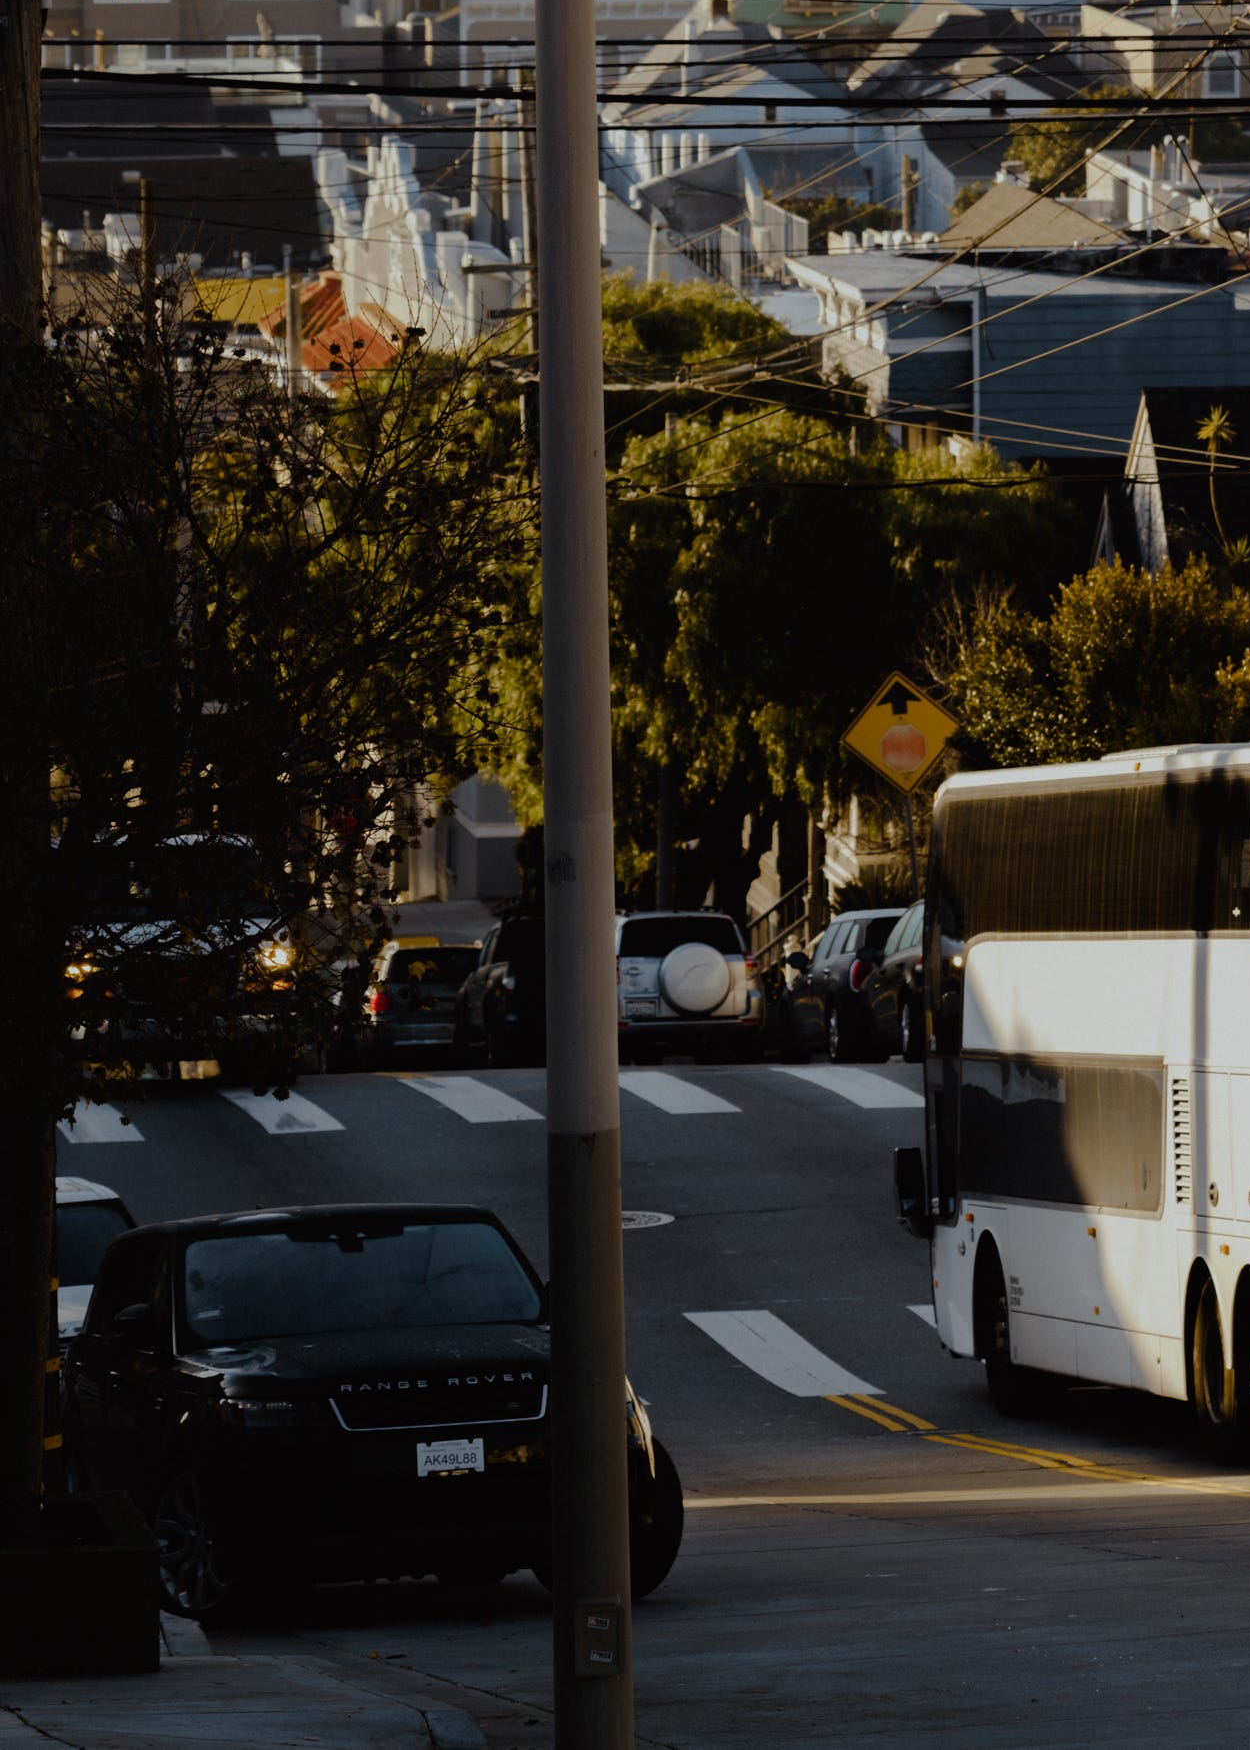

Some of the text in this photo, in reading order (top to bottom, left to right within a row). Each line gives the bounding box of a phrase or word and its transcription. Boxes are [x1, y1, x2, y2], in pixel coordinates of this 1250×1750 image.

[340, 1372, 534, 1392] RANGE ROVER
[424, 1453, 477, 1466] AK49L88
